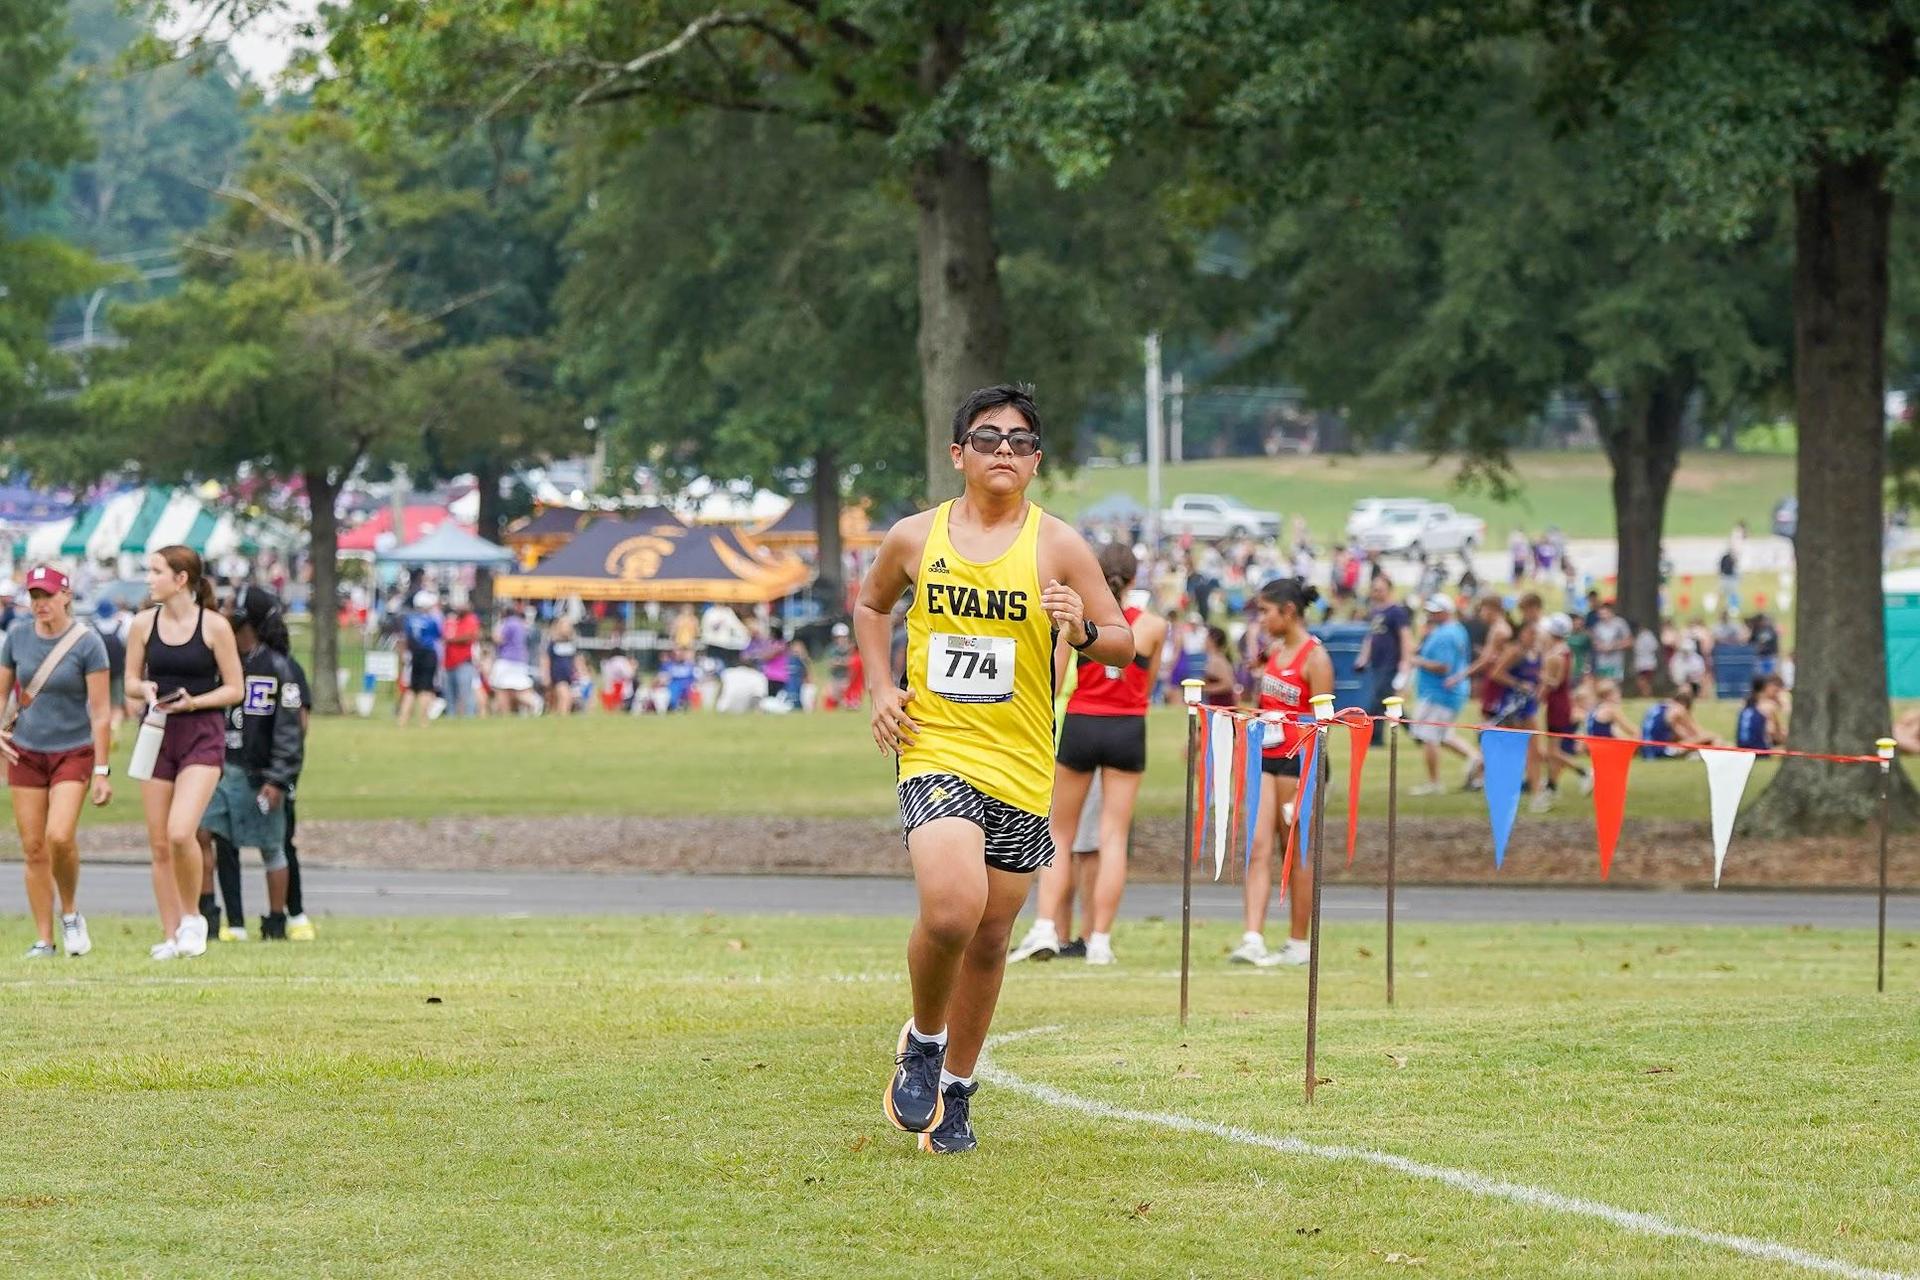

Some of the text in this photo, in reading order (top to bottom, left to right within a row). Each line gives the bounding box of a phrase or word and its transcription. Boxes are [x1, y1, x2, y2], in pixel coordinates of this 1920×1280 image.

[928, 567, 950, 575] adidas
[927, 584, 1027, 621] EVANS
[945, 650, 998, 679] 774
[244, 676, 277, 715] E
